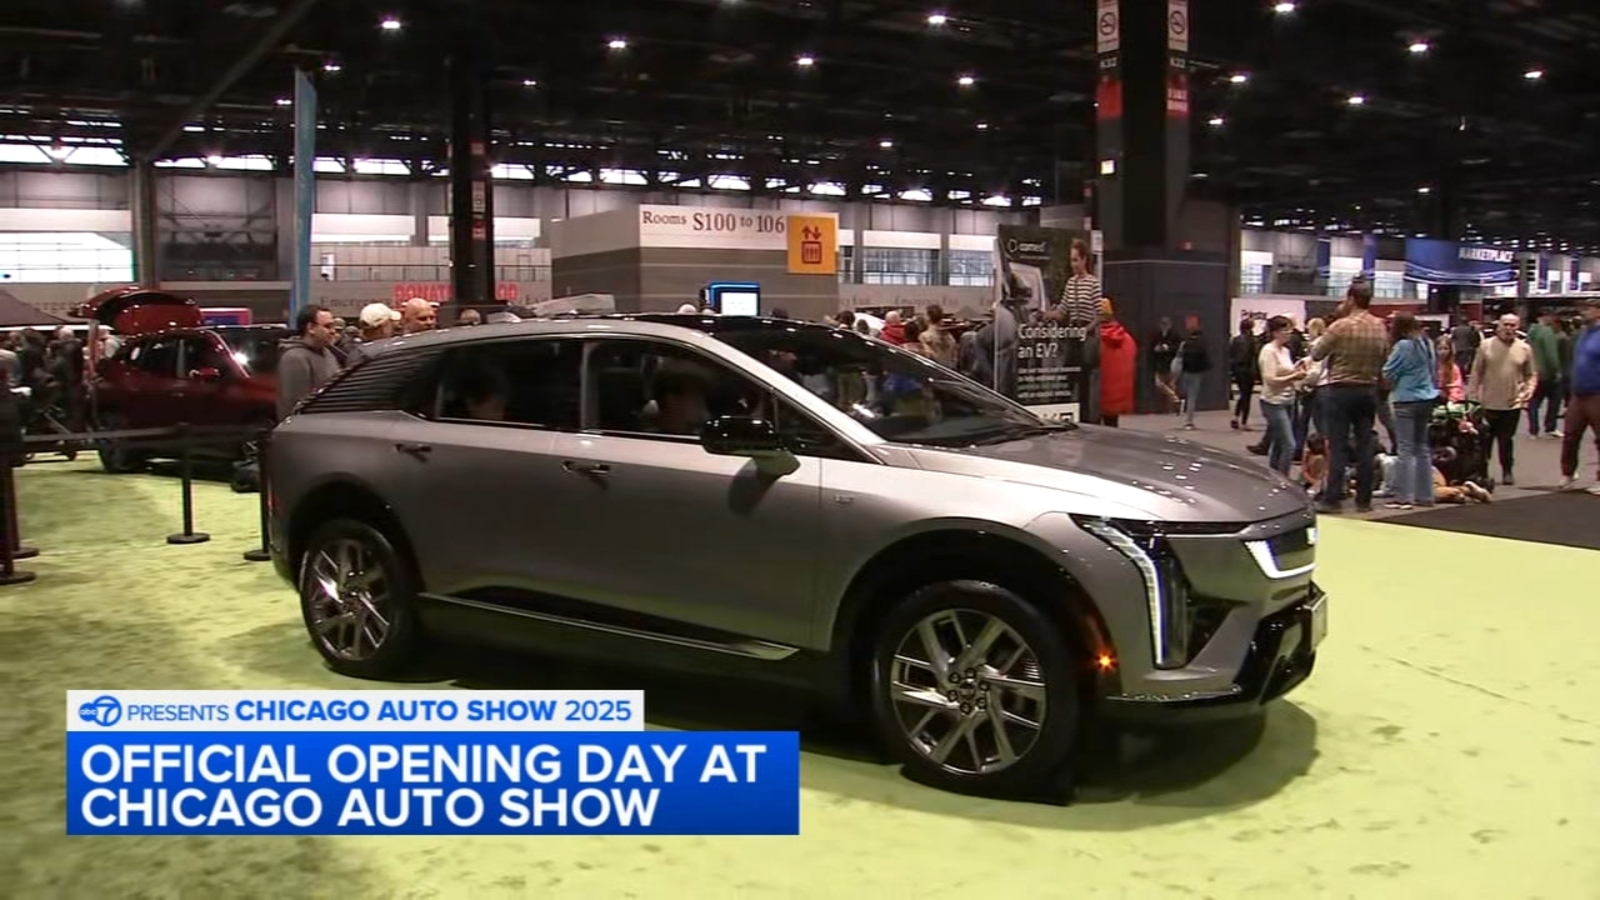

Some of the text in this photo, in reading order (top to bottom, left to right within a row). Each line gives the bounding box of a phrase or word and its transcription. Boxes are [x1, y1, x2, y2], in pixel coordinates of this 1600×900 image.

[642, 211, 785, 233] Rooms S100 to 106
[1459, 247, 1514, 263] MARKETPLACE
[1019, 321, 1087, 341] Considering
[1018, 342, 1059, 359] an EV?
